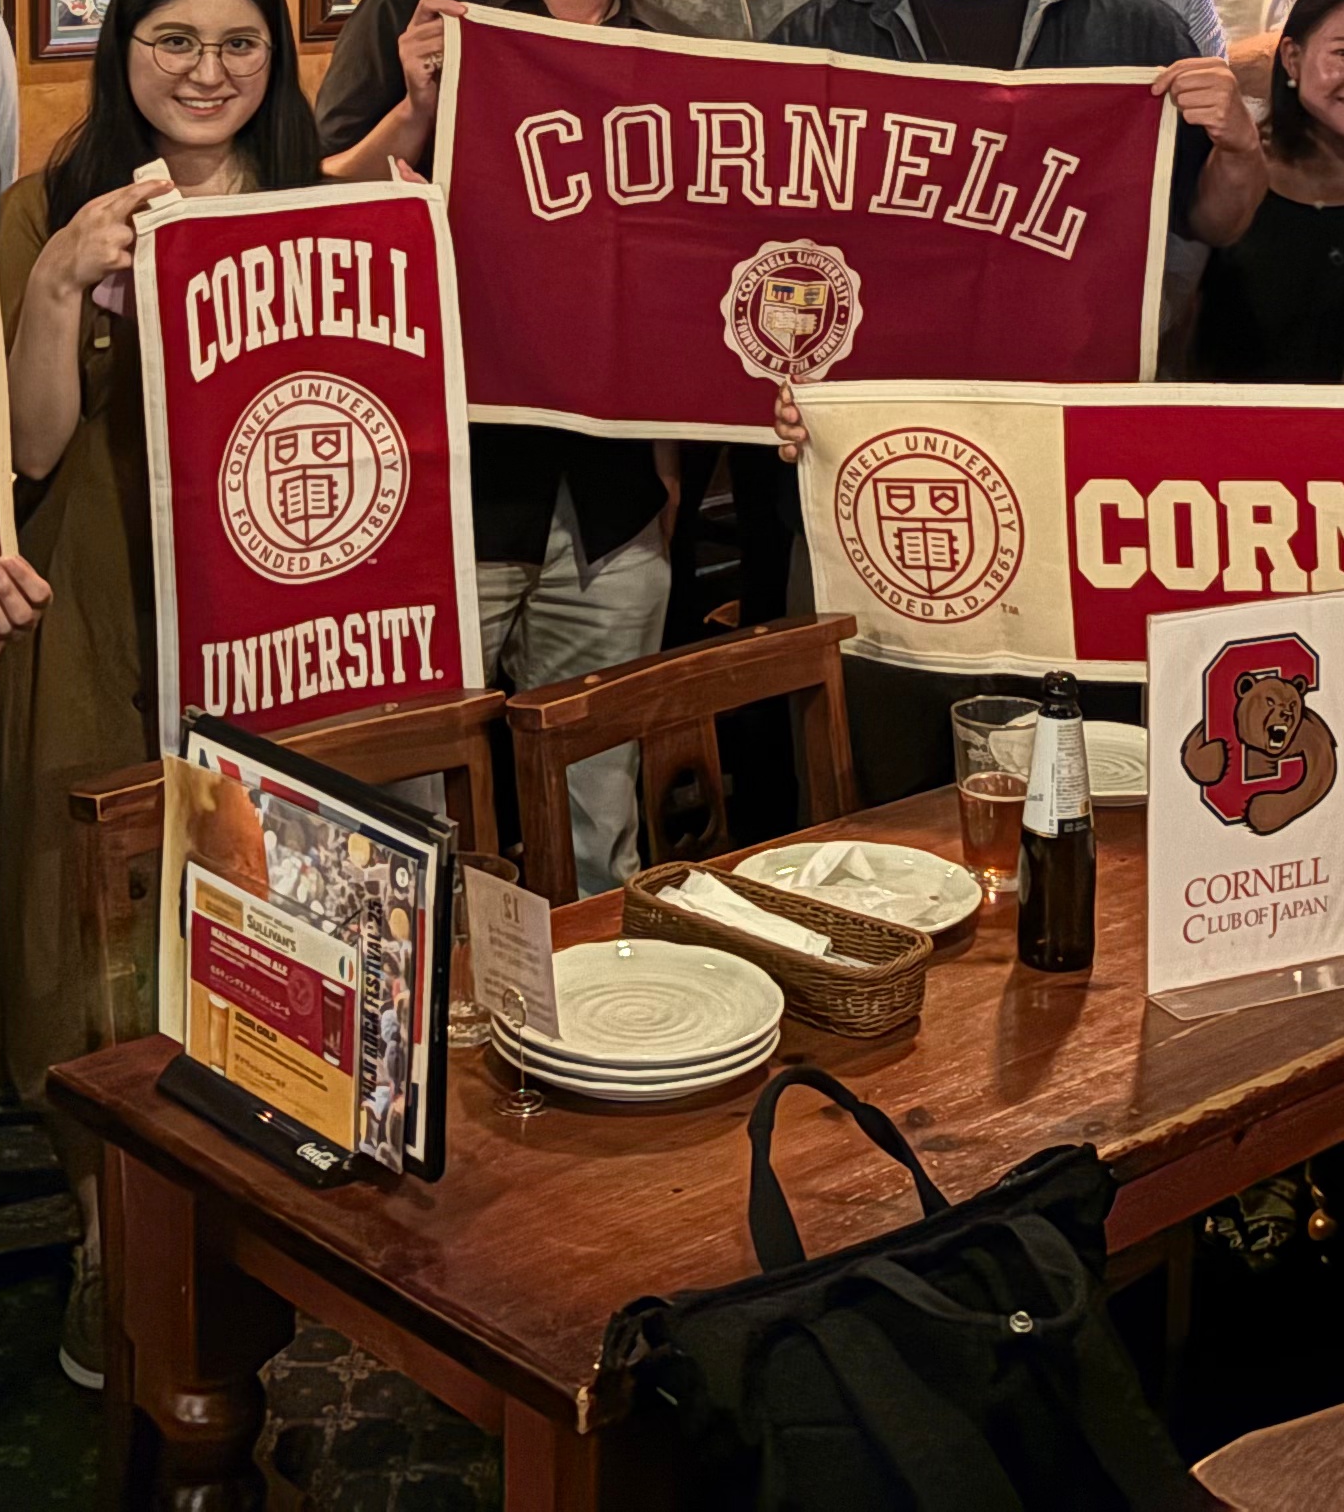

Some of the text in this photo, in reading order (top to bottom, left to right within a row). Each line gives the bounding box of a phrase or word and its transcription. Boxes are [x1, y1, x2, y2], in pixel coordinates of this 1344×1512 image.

[515, 102, 1087, 260] CORNELL
[185, 237, 426, 383] CORNELL
[737, 252, 850, 308] CORNELL UNIVERSITY
[736, 316, 767, 361] FOUNDED
[769, 357, 784, 371] BY
[813, 323, 846, 363] CORNELL
[227, 382, 400, 492] CORNELL UNIVERSITY
[840, 434, 1017, 533] CORNELL UNIVERSITY
[232, 487, 397, 573] FOUNDED A.D. 1865
[845, 536, 1015, 618] FOUNDED A.D. 1865
[999, 602, 1020, 616] TM
[1184, 856, 1330, 908] CORNELL
[1244, 907, 1269, 928] OF
[1267, 895, 1328, 939] JAPAN
[364, 930, 382, 1010] FESTIVAL
